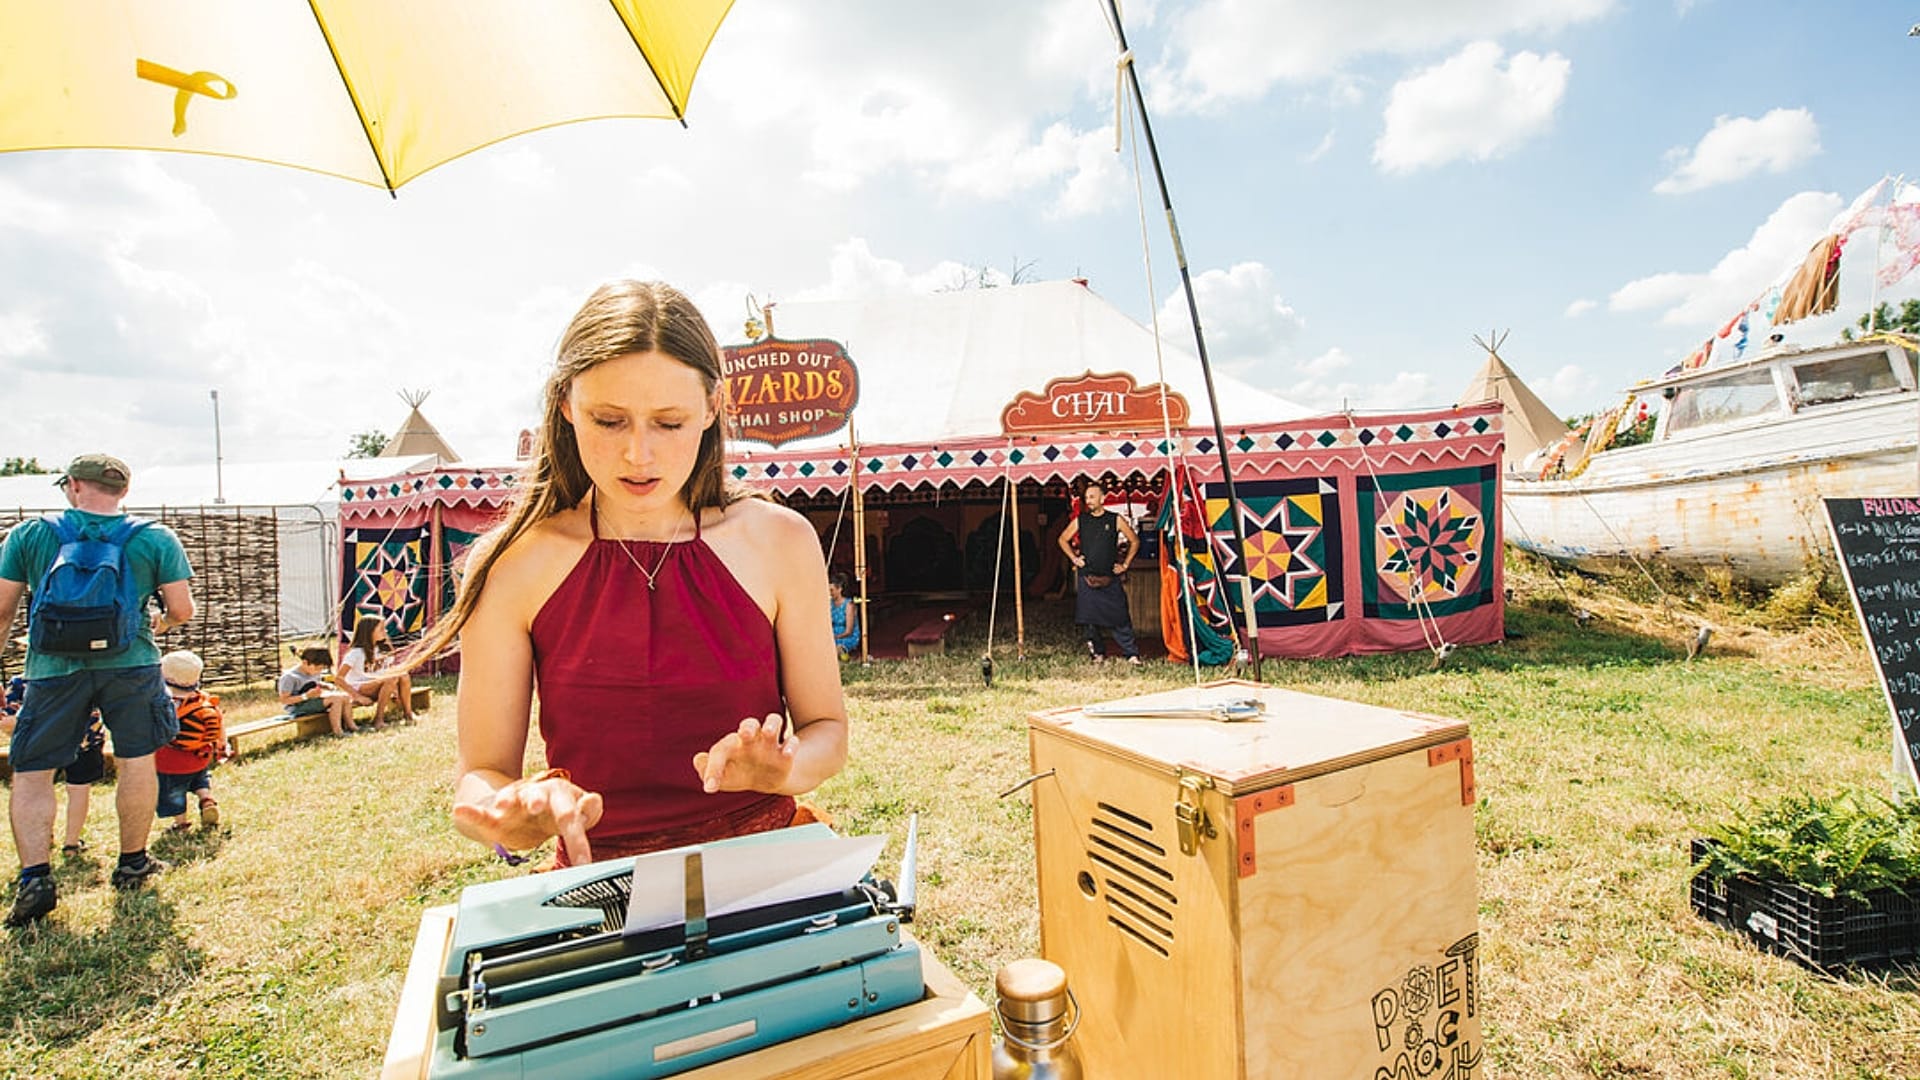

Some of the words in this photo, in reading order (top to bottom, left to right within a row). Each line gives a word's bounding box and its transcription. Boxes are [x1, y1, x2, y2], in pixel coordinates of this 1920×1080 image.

[723, 352, 790, 375] UNCHED
[797, 351, 832, 368] OUT
[723, 369, 844, 415] IZARDS
[1052, 390, 1127, 421] CHAI
[728, 412, 770, 428] CHAI
[778, 408, 824, 425] SHOP
[1861, 497, 1920, 517] FRIDA
